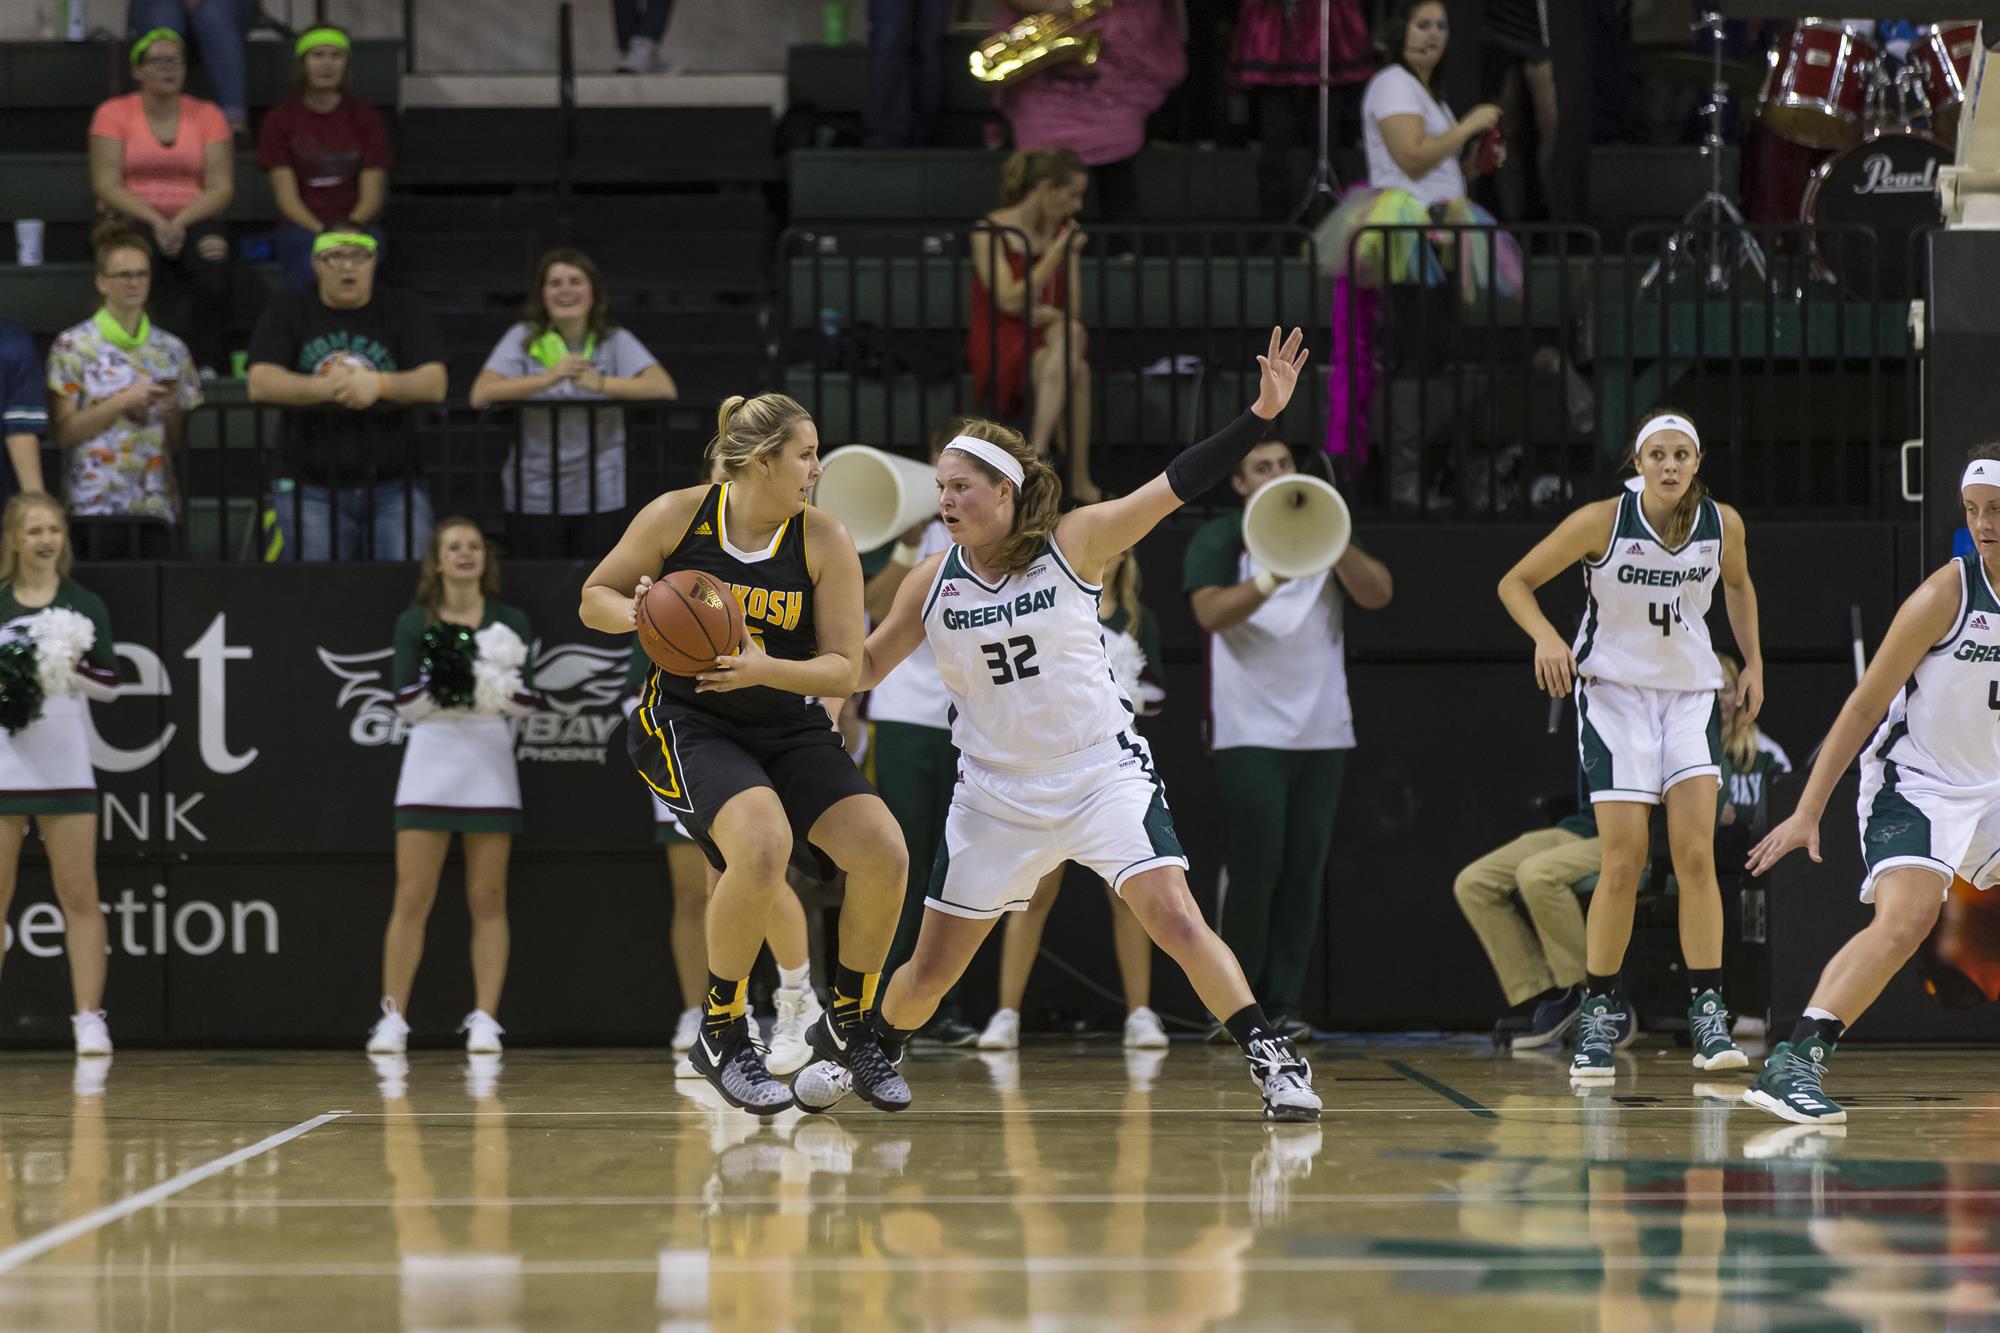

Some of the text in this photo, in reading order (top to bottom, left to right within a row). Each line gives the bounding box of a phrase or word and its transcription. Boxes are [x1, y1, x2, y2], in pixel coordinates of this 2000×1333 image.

[1853, 153, 1937, 194] Pearl
[1617, 564, 1687, 588] GREEN
[724, 582, 803, 631] KOSH
[943, 586, 1057, 630] GREEN BAY
[980, 634, 1041, 685] 32
[91, 611, 260, 774] et
[523, 712, 623, 745] BAY
